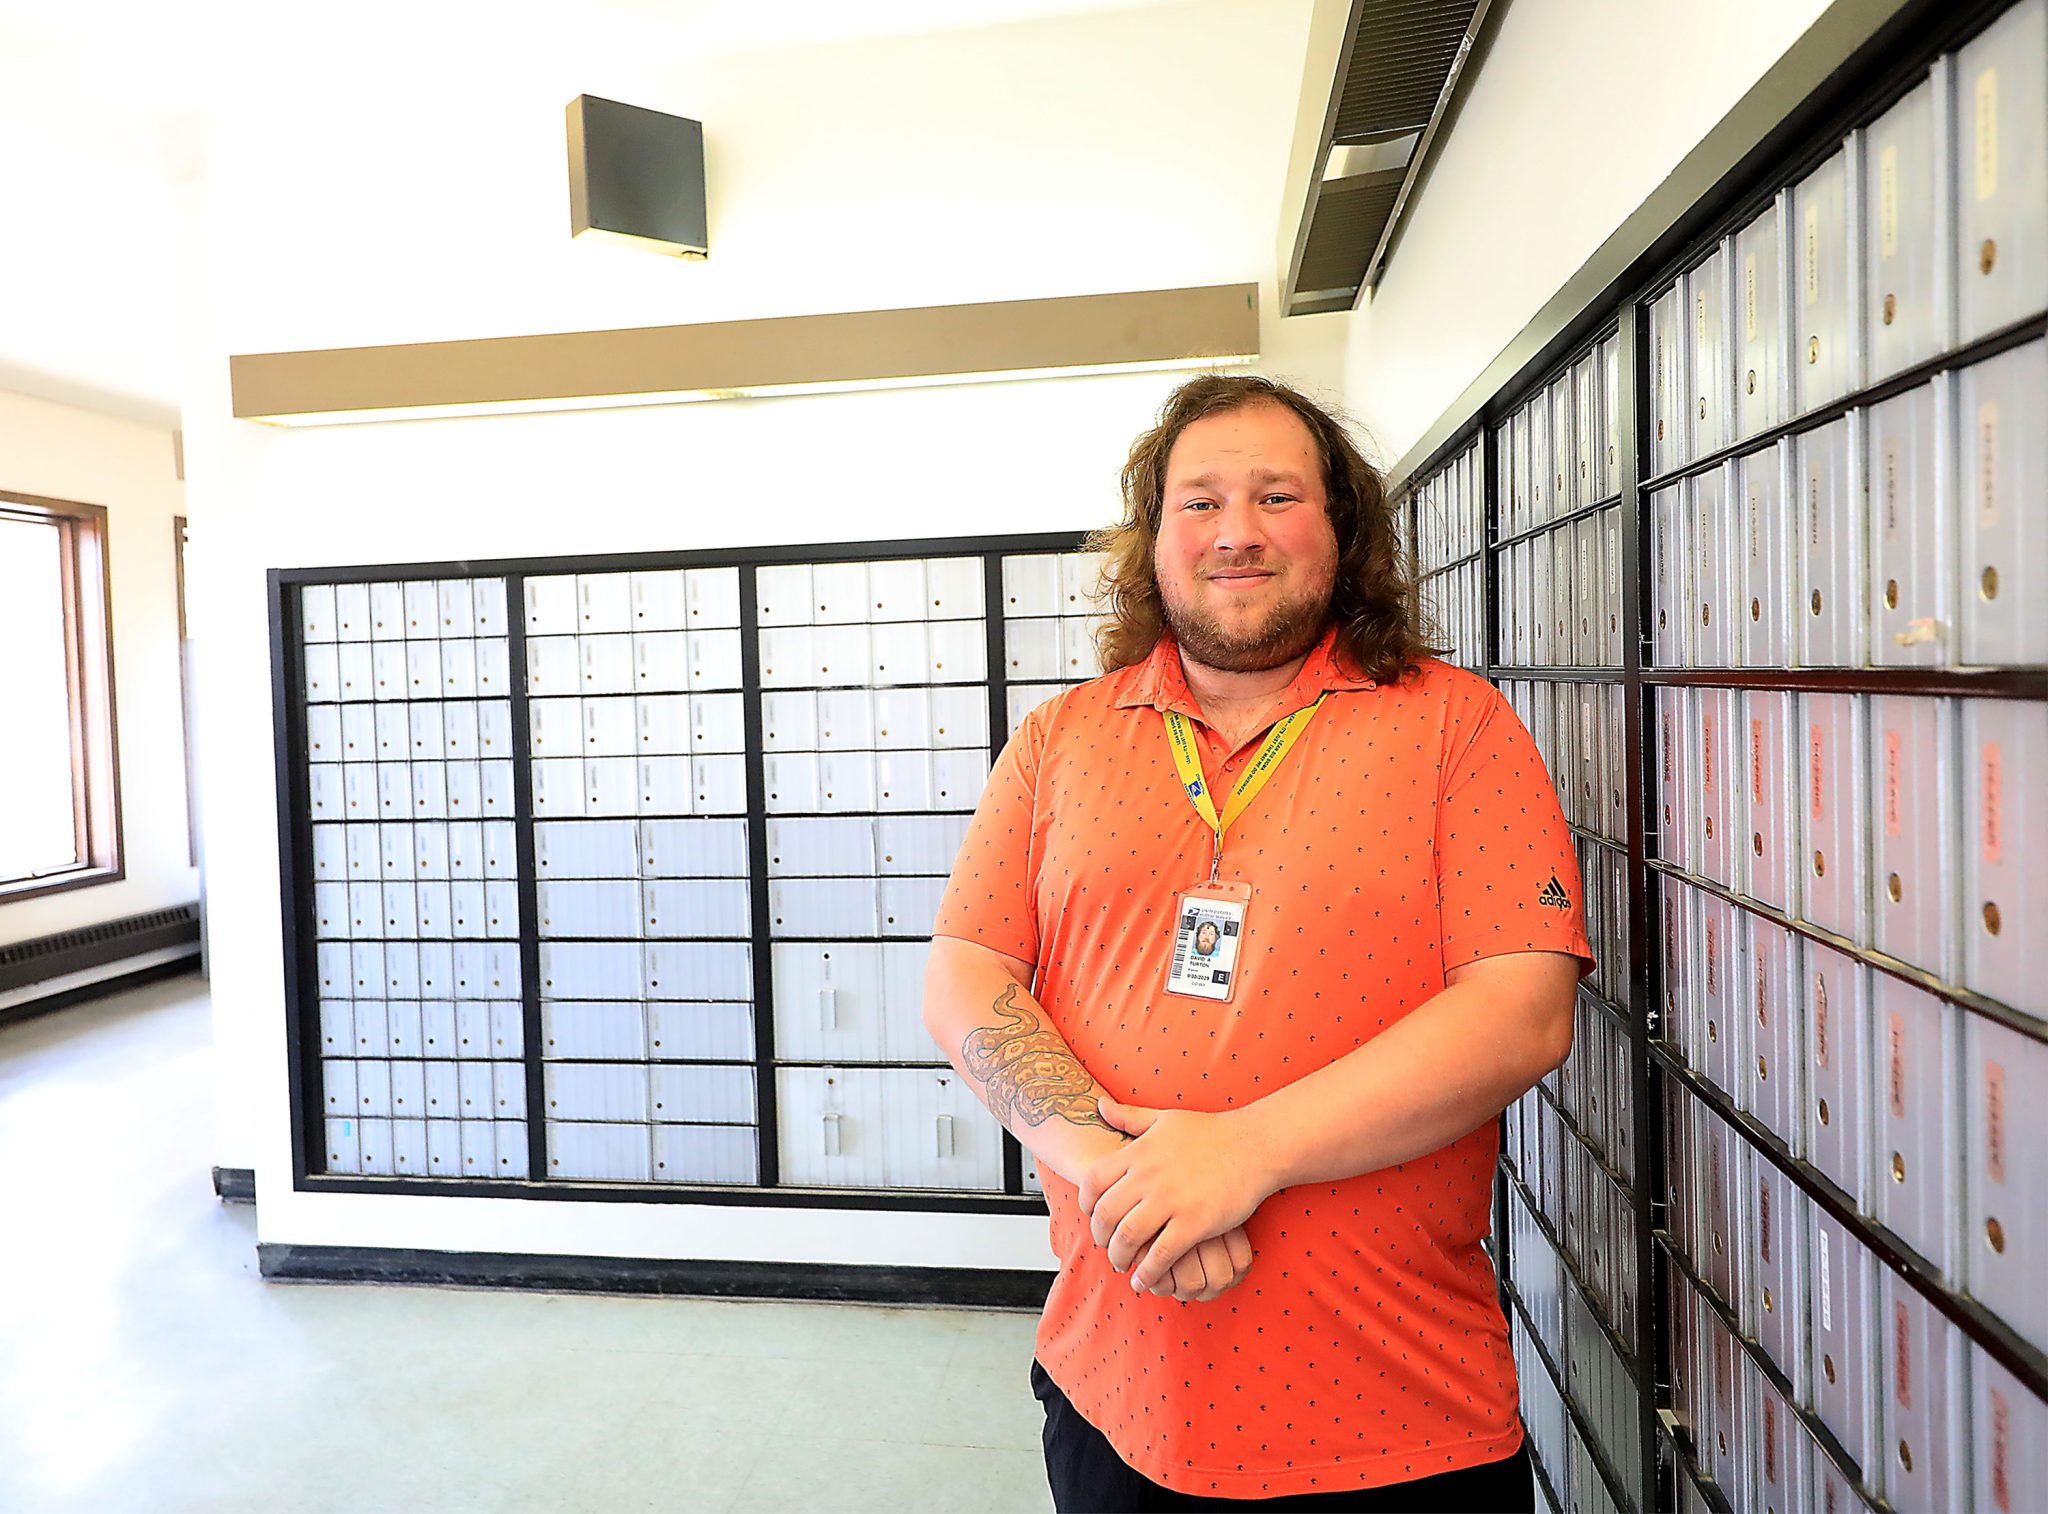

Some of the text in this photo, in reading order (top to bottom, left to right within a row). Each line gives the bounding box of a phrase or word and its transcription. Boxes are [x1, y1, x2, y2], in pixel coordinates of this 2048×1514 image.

[1266, 744, 1275, 753] THE
[1260, 739, 1285, 771] LEAN SIX SIGMA
[1260, 752, 1268, 761] WAY
[1237, 773, 1253, 796] BUSINESS
[1538, 893, 1572, 909] adidas
[1190, 960, 1210, 968] TURTON
[1218, 974, 1225, 982] E
